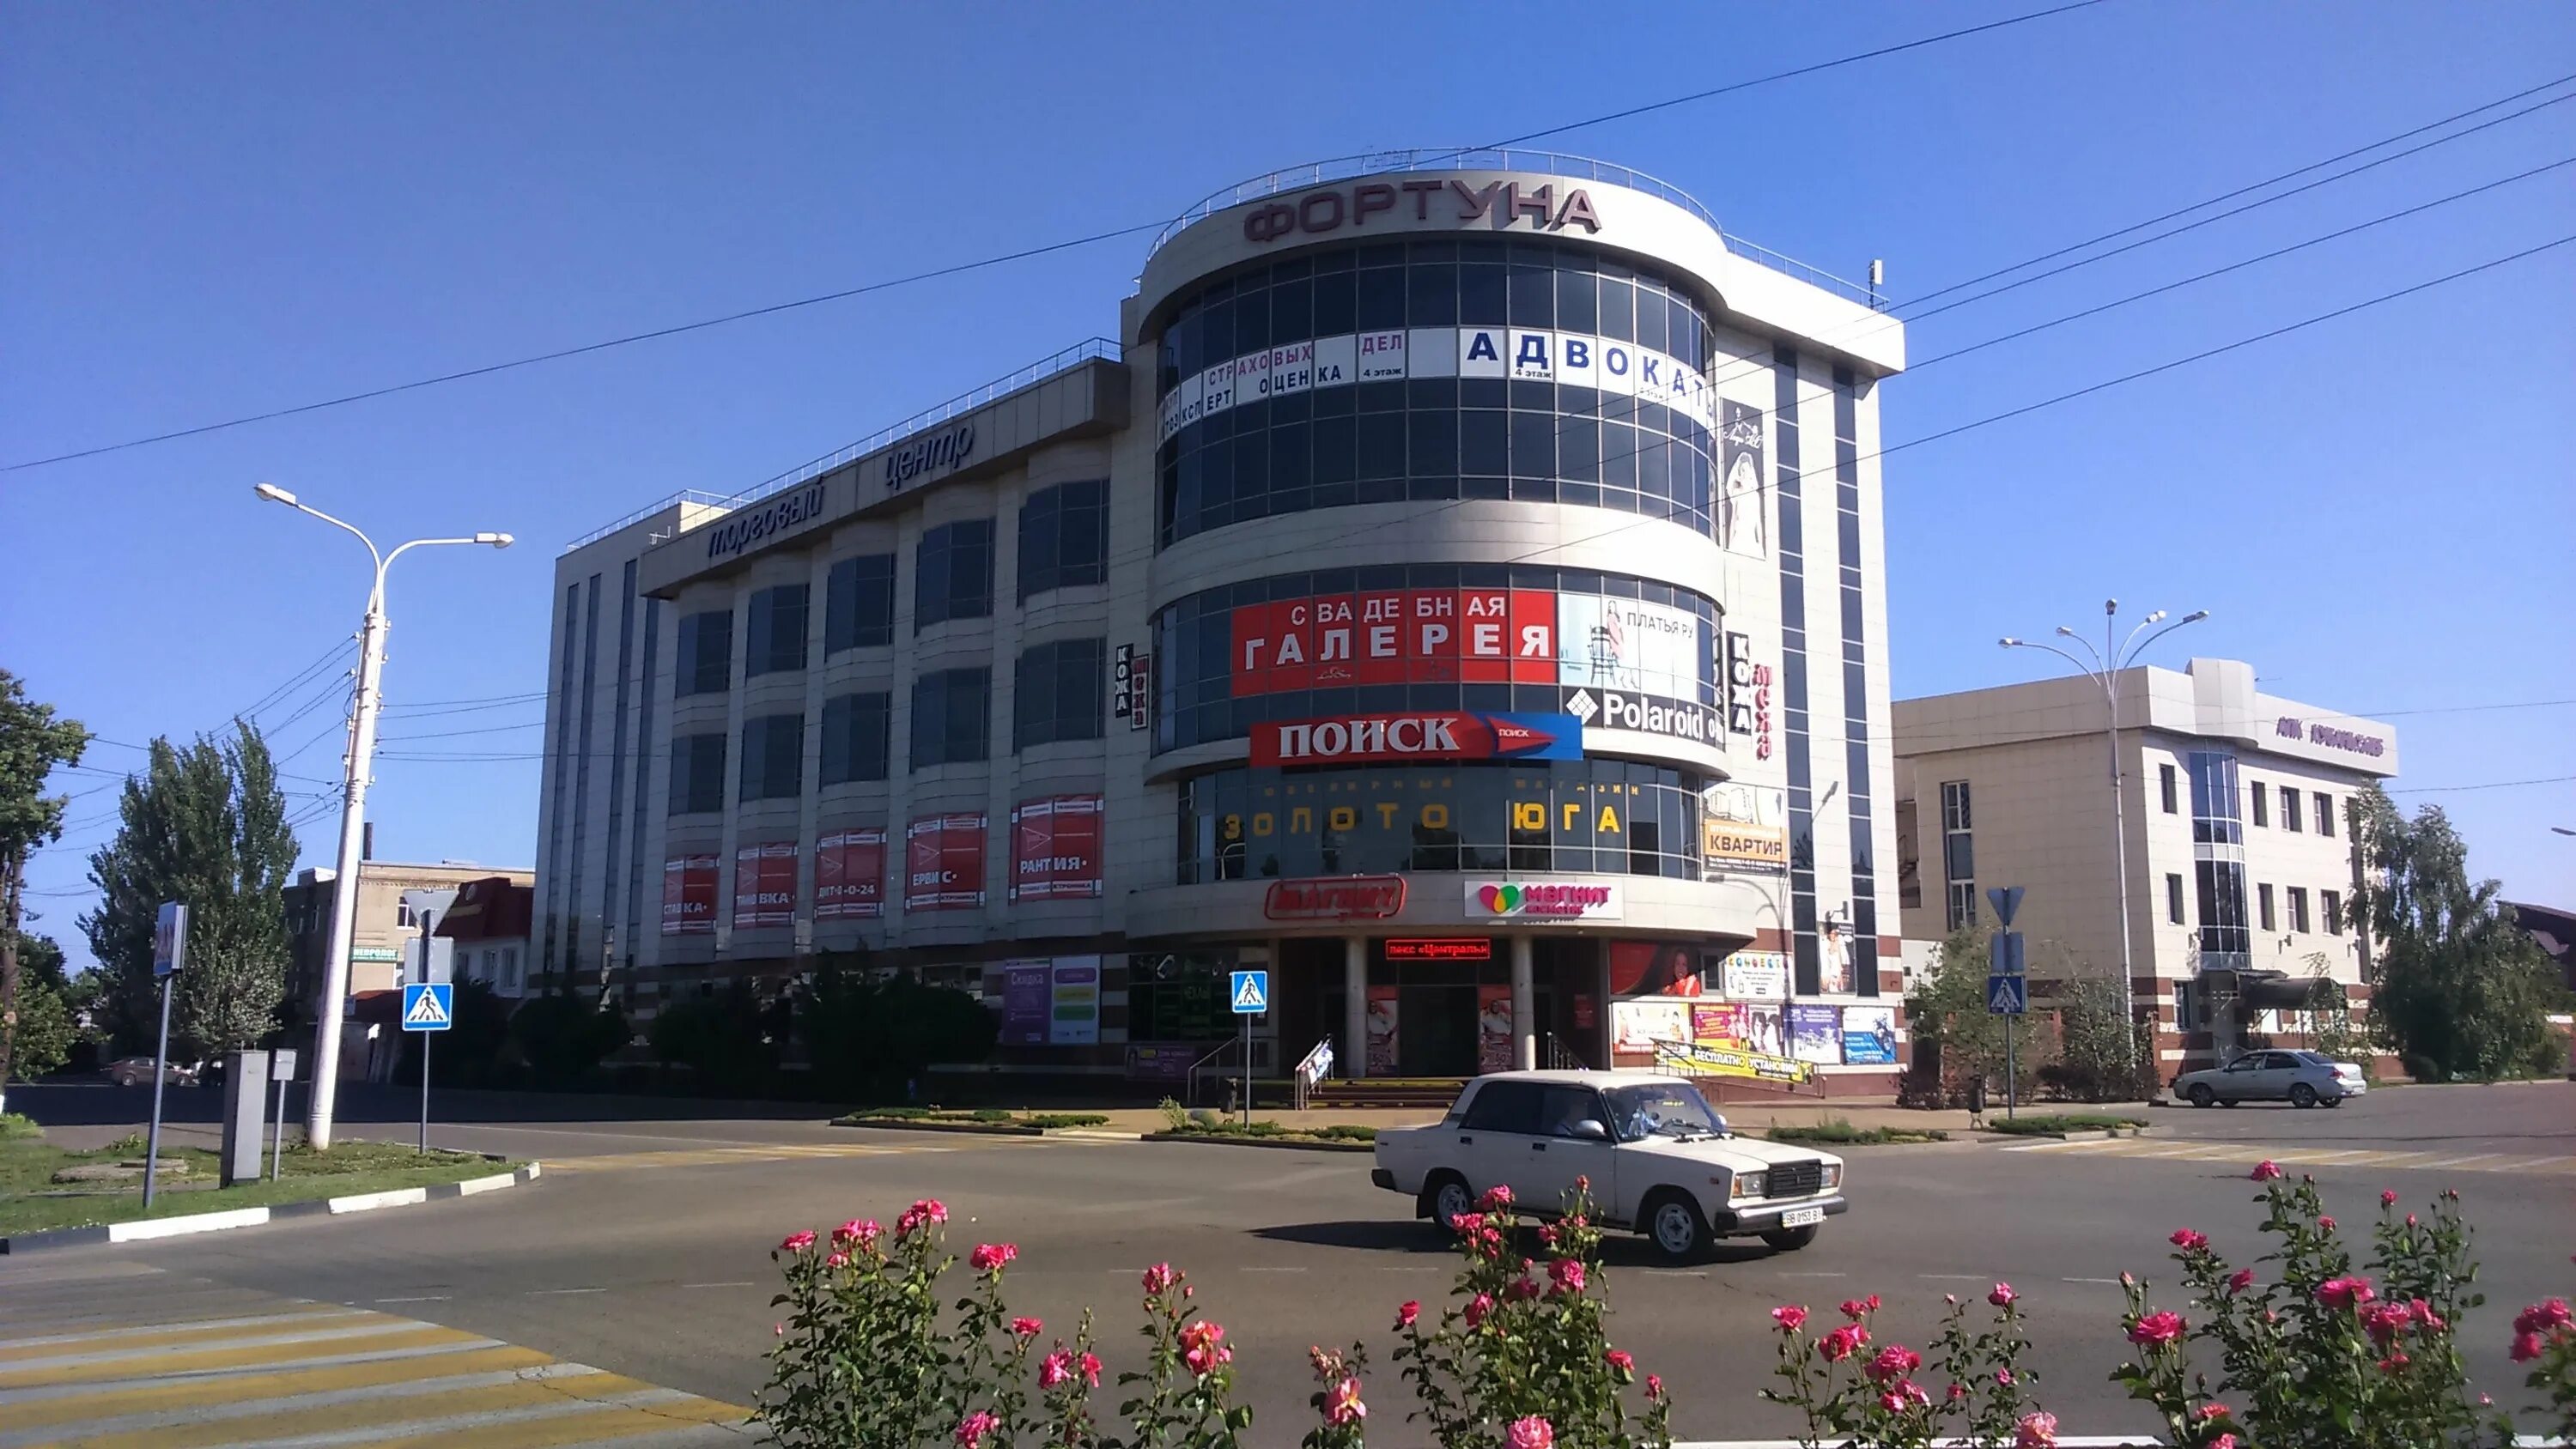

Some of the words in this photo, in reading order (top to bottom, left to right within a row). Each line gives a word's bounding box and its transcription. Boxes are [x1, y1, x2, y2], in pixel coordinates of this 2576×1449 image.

[1243, 179, 1602, 242] ФОРТУНА
[1208, 344, 1312, 385] СТРАХОВЫХ
[1362, 334, 1402, 355] ДЕЛ
[1259, 365, 1341, 393] ОЦЕНКА
[1364, 369, 1370, 378] 4
[1627, 612, 1679, 634] ПЛАТЬЯ
[1245, 623, 1549, 670] ГАЛЕРЕЯ
[1498, 728, 1529, 738] ПОИСК
[1604, 694, 1704, 741] Polaroid
[1278, 718, 1461, 759] ПОИСК
[1224, 802, 1449, 840] ЗОЛОТО
[1514, 798, 1620, 833] ЮГА
[1694, 1050, 1746, 1068] БЕСПЛАТНО
